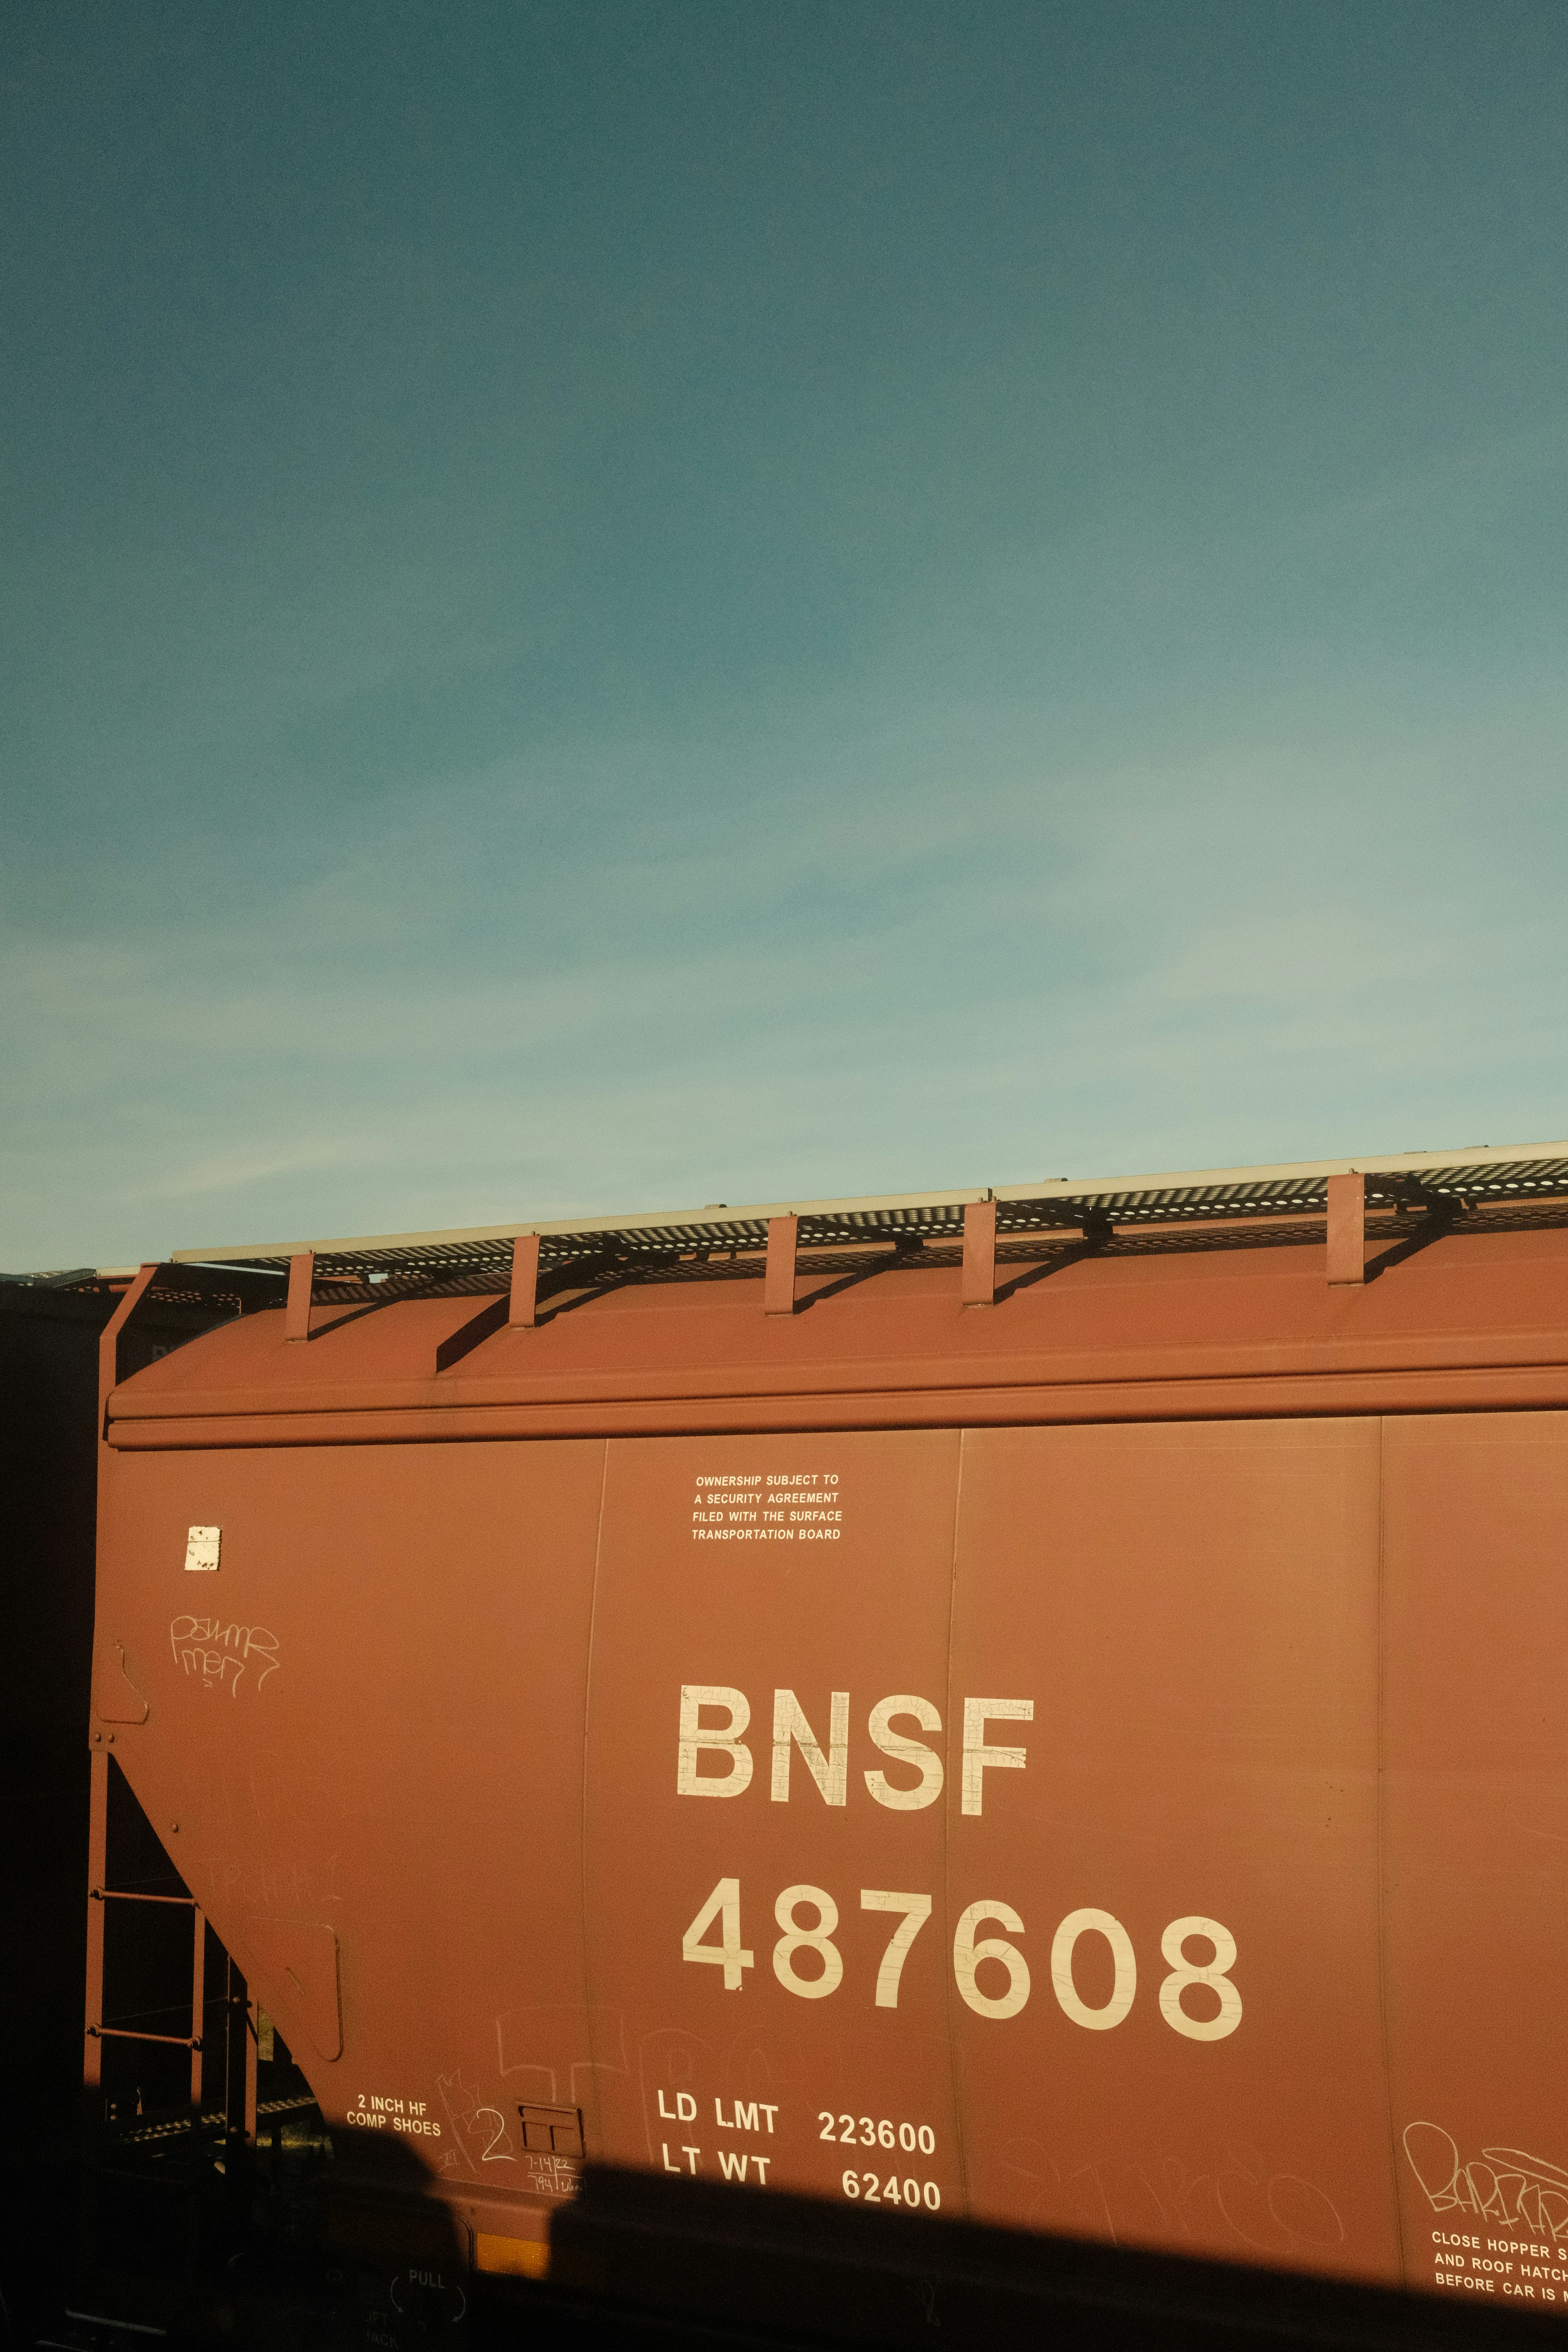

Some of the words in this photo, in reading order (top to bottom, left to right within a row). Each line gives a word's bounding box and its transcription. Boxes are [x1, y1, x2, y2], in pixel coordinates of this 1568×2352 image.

[677, 1568, 1034, 1685] BNSF
[692, 1529, 794, 1539] TRANSPORTATION
[799, 1529, 840, 1539] BOARD
[693, 1512, 723, 1522] FILED
[729, 1511, 756, 1521] WITH
[763, 1511, 784, 1521] THE
[790, 1511, 842, 1521] SURFACE
[694, 1494, 701, 1504] A
[707, 1493, 762, 1504] SECURITY
[767, 1493, 839, 1503] AGREEMENT
[696, 1476, 761, 1486] OWNERSHIP
[766, 1475, 818, 1485] SUBJECT
[823, 1475, 838, 1484] TO
[347, 1568, 386, 2111] COMP
[393, 1568, 441, 2117] SHOES
[358, 1568, 366, 2094] 2
[371, 1568, 403, 2096] INCH
[409, 1568, 426, 2101] HF
[658, 1568, 697, 2090] LD
[715, 1568, 778, 2098] LMT
[818, 1568, 935, 2112] 223600
[662, 1568, 700, 2143] LT
[718, 1568, 770, 2151] WT
[842, 1568, 940, 2170] 62400
[682, 1568, 1243, 1878] 487608
[1432, 1568, 1480, 2231] CLOSE
[1487, 1568, 1550, 2239] HOPPER
[1435, 1568, 1464, 2252] AND
[1472, 1568, 1513, 2257] ROOF
[1435, 1568, 1494, 2272] BEFORE
[1503, 1568, 1534, 2282] CAR
[1542, 1568, 1555, 2288] IS
[409, 2269, 447, 2289] PULL
